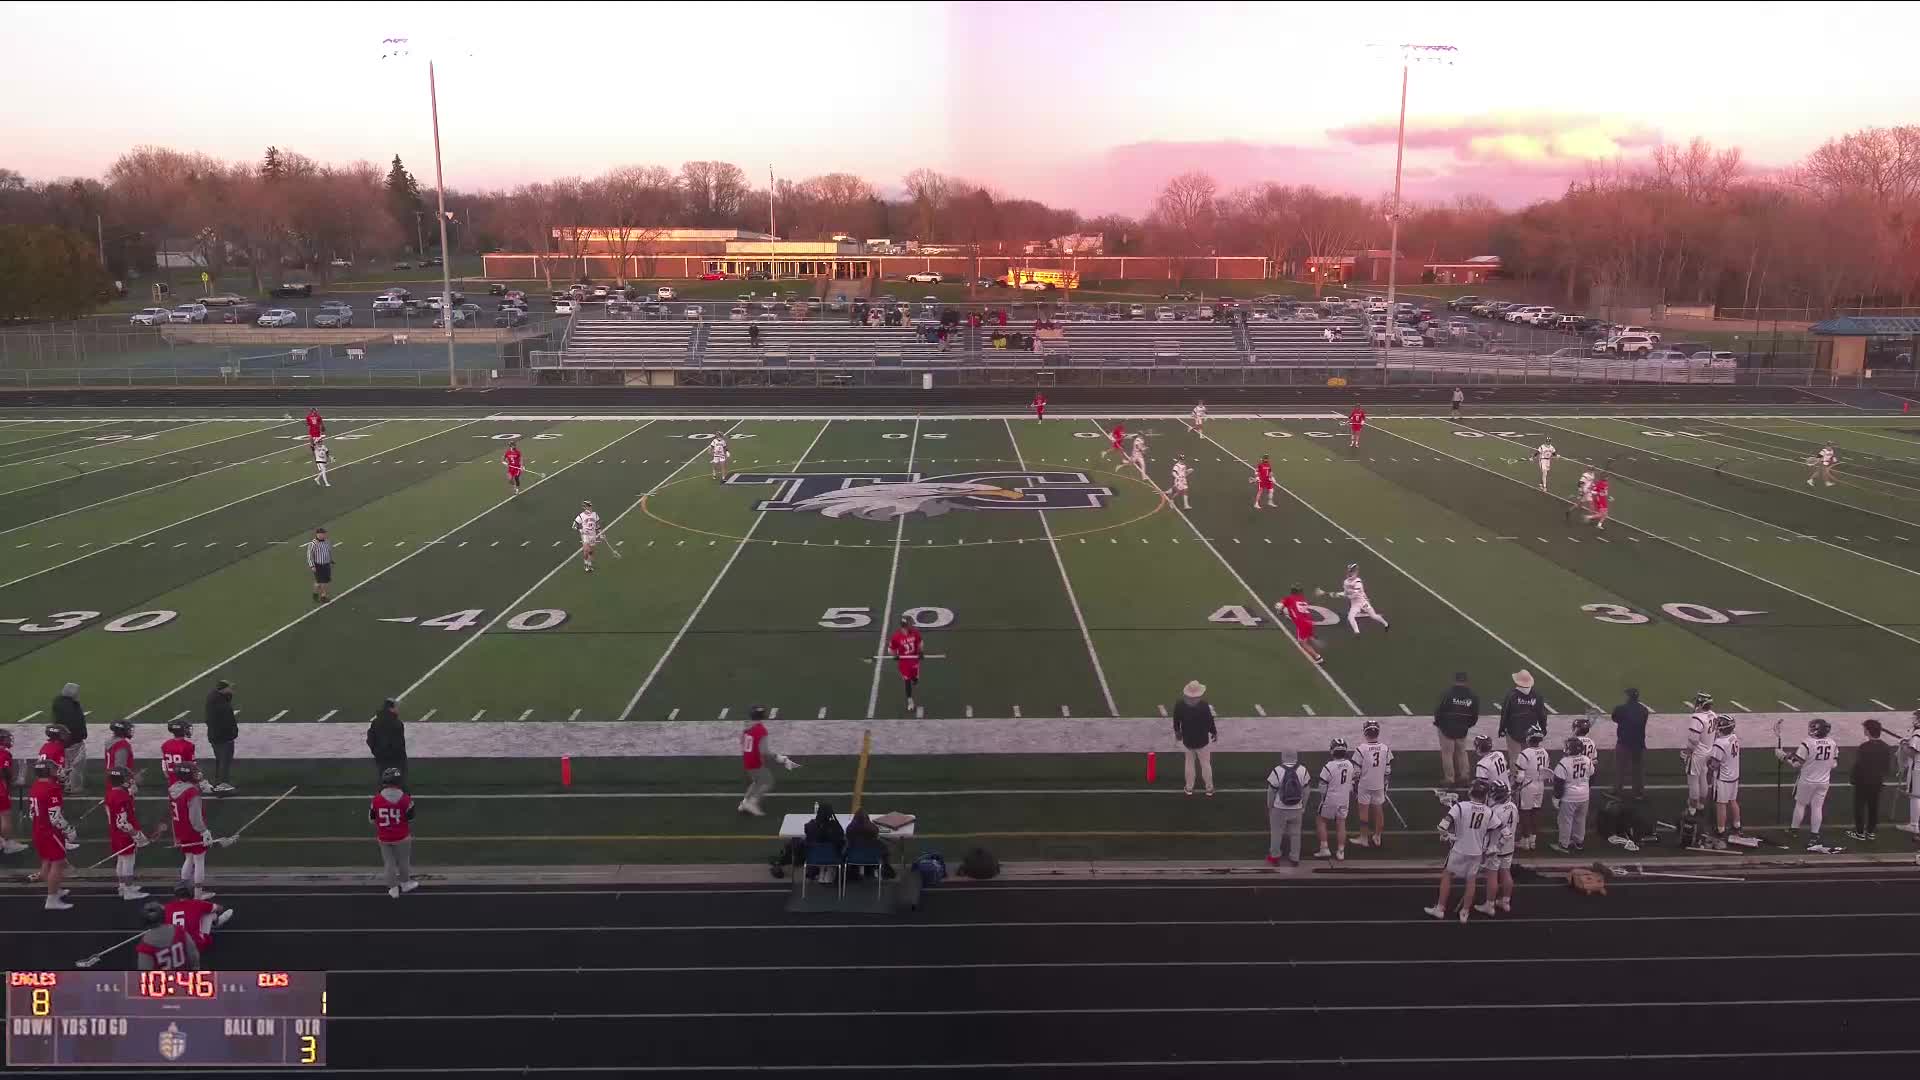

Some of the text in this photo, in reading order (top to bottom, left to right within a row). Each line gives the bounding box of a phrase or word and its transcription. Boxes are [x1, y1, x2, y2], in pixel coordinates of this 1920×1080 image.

[1371, 751, 1381, 768] 3
[1815, 745, 1832, 761] 26
[1494, 757, 1506, 776] 16
[1573, 763, 1587, 780] 25
[1340, 768, 1349, 785] 6
[378, 808, 401, 827] 54
[1470, 812, 1485, 829] 18
[156, 942, 186, 970] 50
